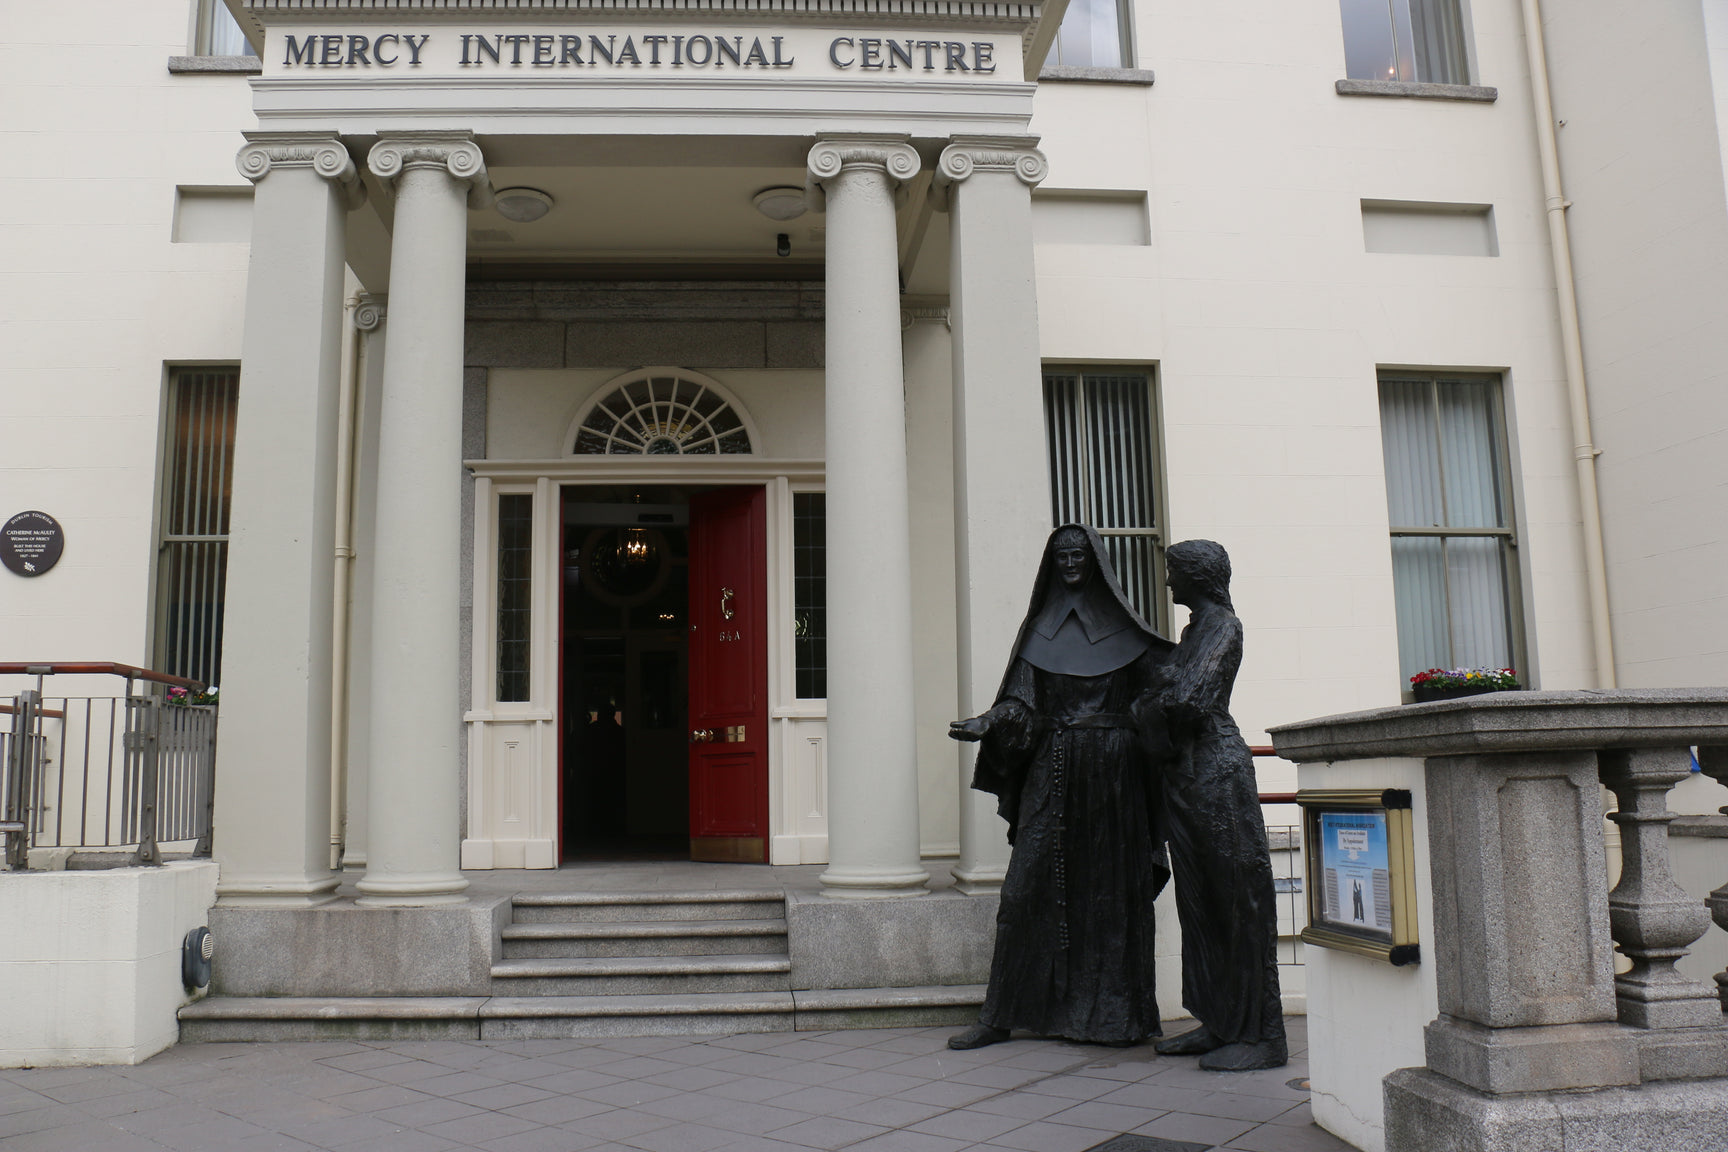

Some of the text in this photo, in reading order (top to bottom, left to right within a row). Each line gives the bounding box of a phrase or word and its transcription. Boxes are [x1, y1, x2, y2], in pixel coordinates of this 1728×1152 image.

[283, 34, 997, 71] MERCY INTERNATIONAL CENTRE
[10, 513, 54, 525] DUBLIN TOURISM
